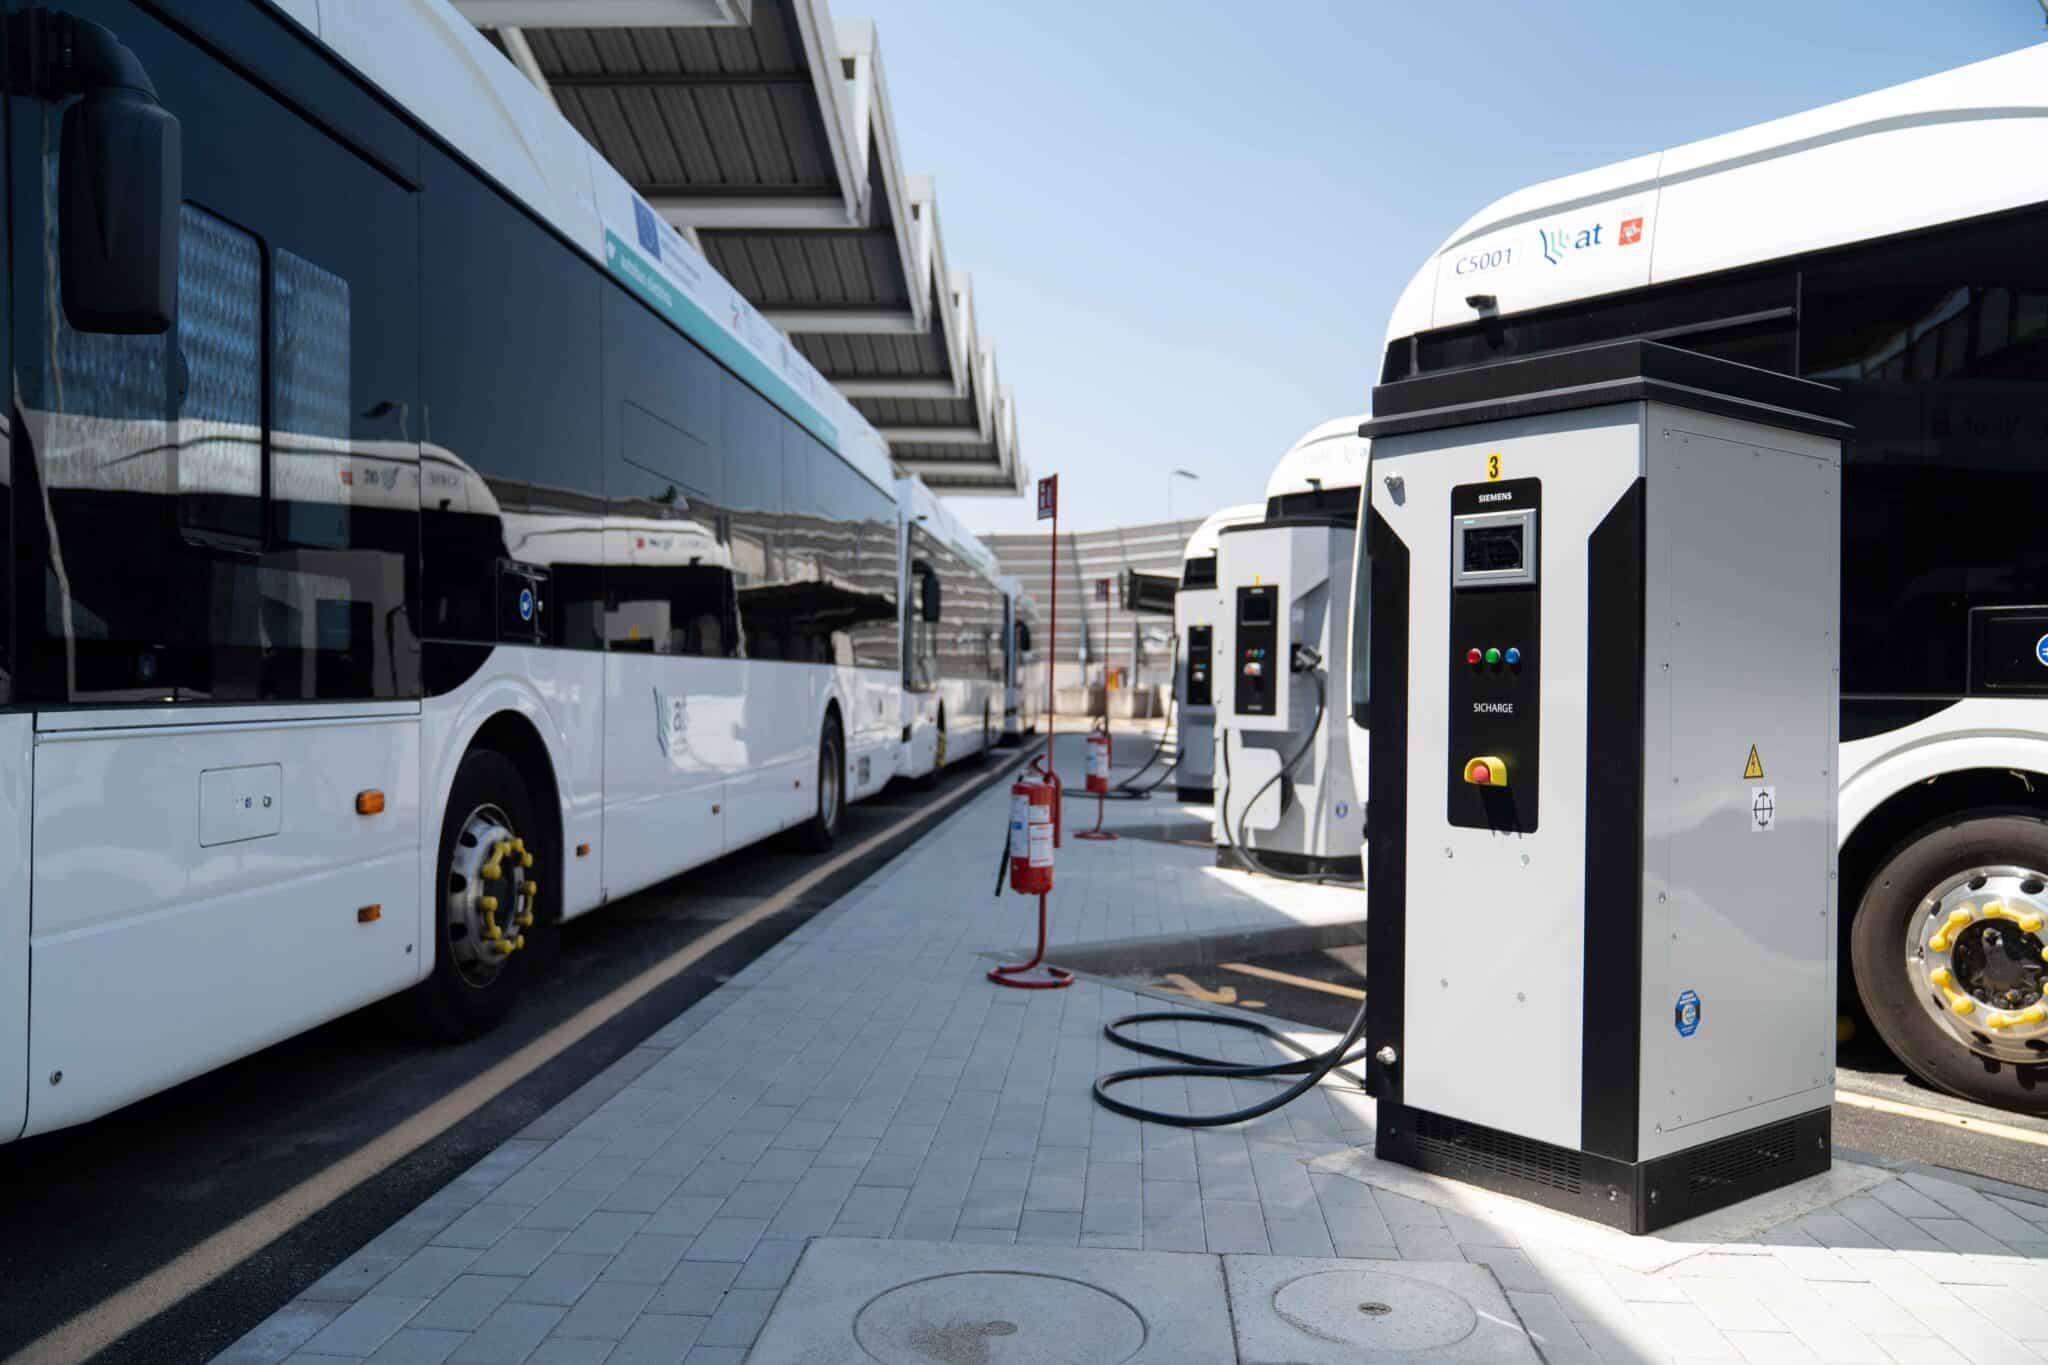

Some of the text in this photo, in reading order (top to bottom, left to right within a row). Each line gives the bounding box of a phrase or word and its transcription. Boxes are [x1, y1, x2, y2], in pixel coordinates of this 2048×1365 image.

[1575, 223, 1602, 249] at
[1456, 248, 1512, 275] C5001
[1489, 455, 1499, 478] 3
[1478, 492, 1512, 503] SIEMENS
[1473, 702, 1514, 713] SICHARGE
